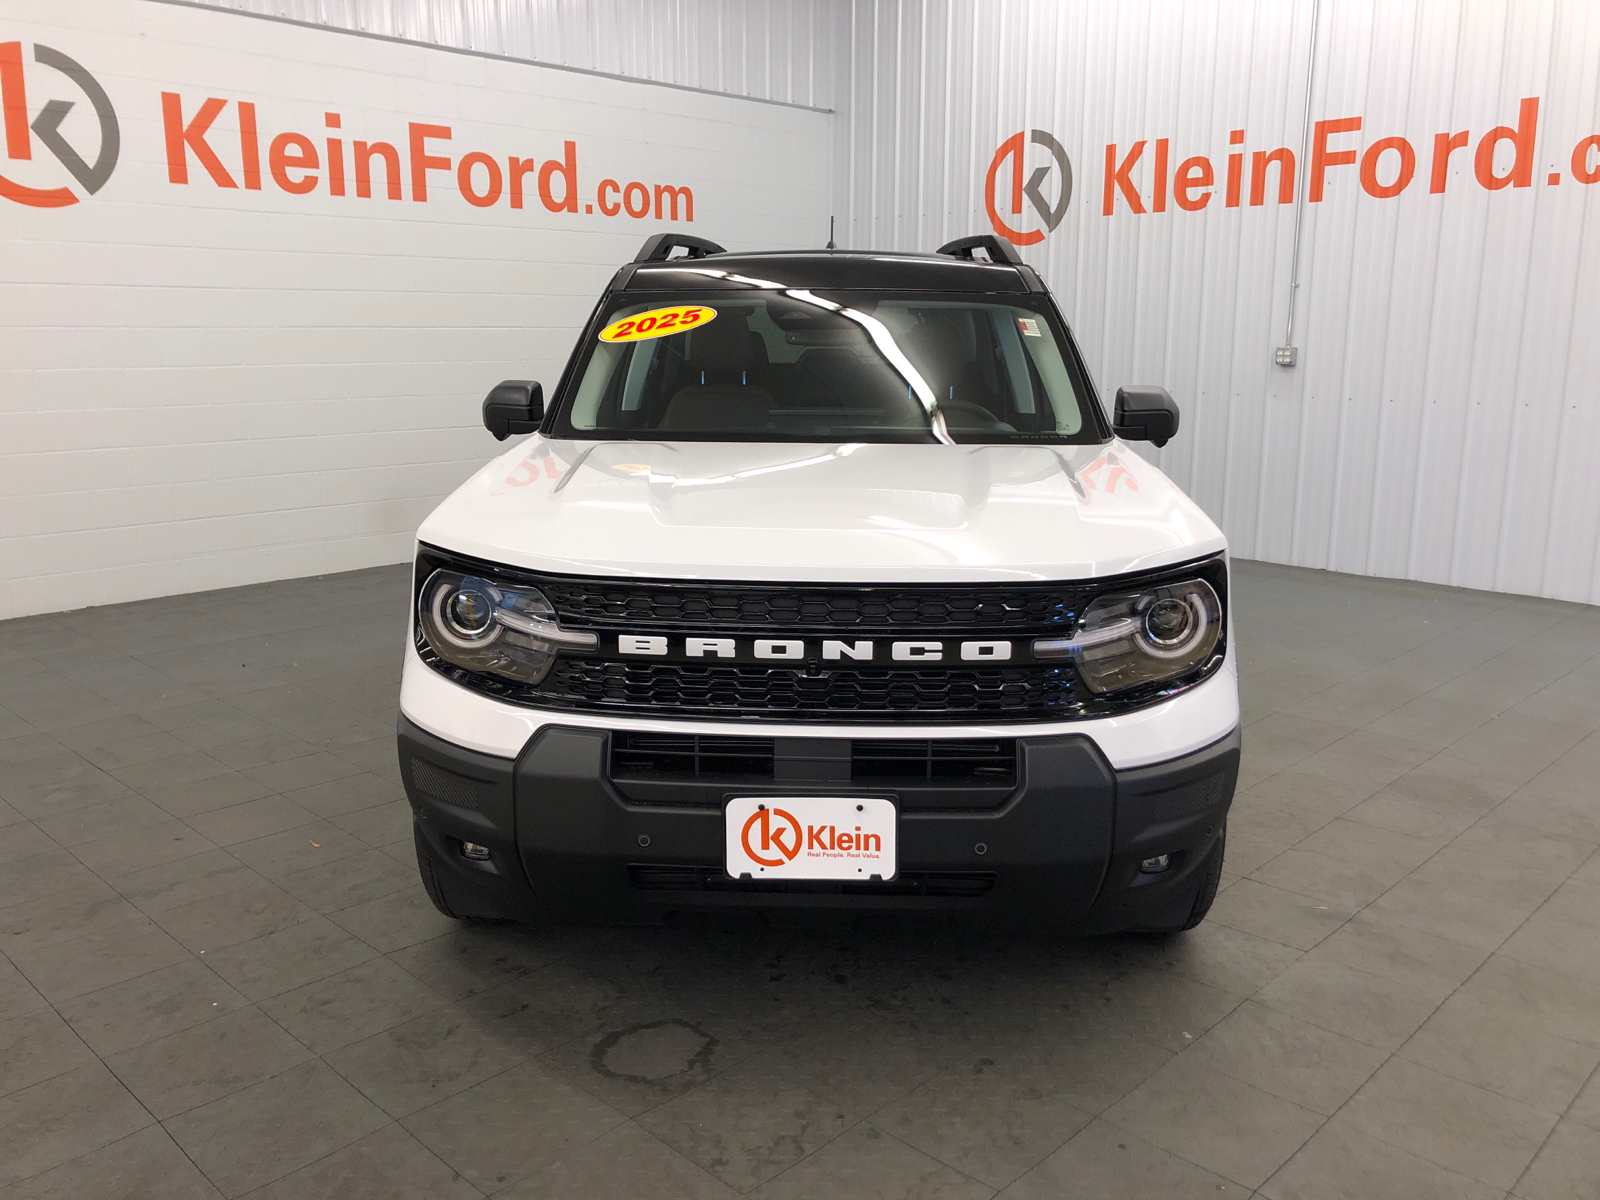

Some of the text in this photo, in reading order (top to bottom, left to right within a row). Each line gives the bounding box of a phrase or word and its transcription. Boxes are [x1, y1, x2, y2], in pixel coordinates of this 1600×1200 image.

[161, 91, 694, 223] KleinFord.com
[612, 308, 702, 339] 2025
[618, 634, 1012, 661] BRONCO
[807, 824, 882, 852] Klein
[822, 851, 845, 859] People.
[846, 851, 861, 859] Real
[862, 852, 881, 860] Value.
